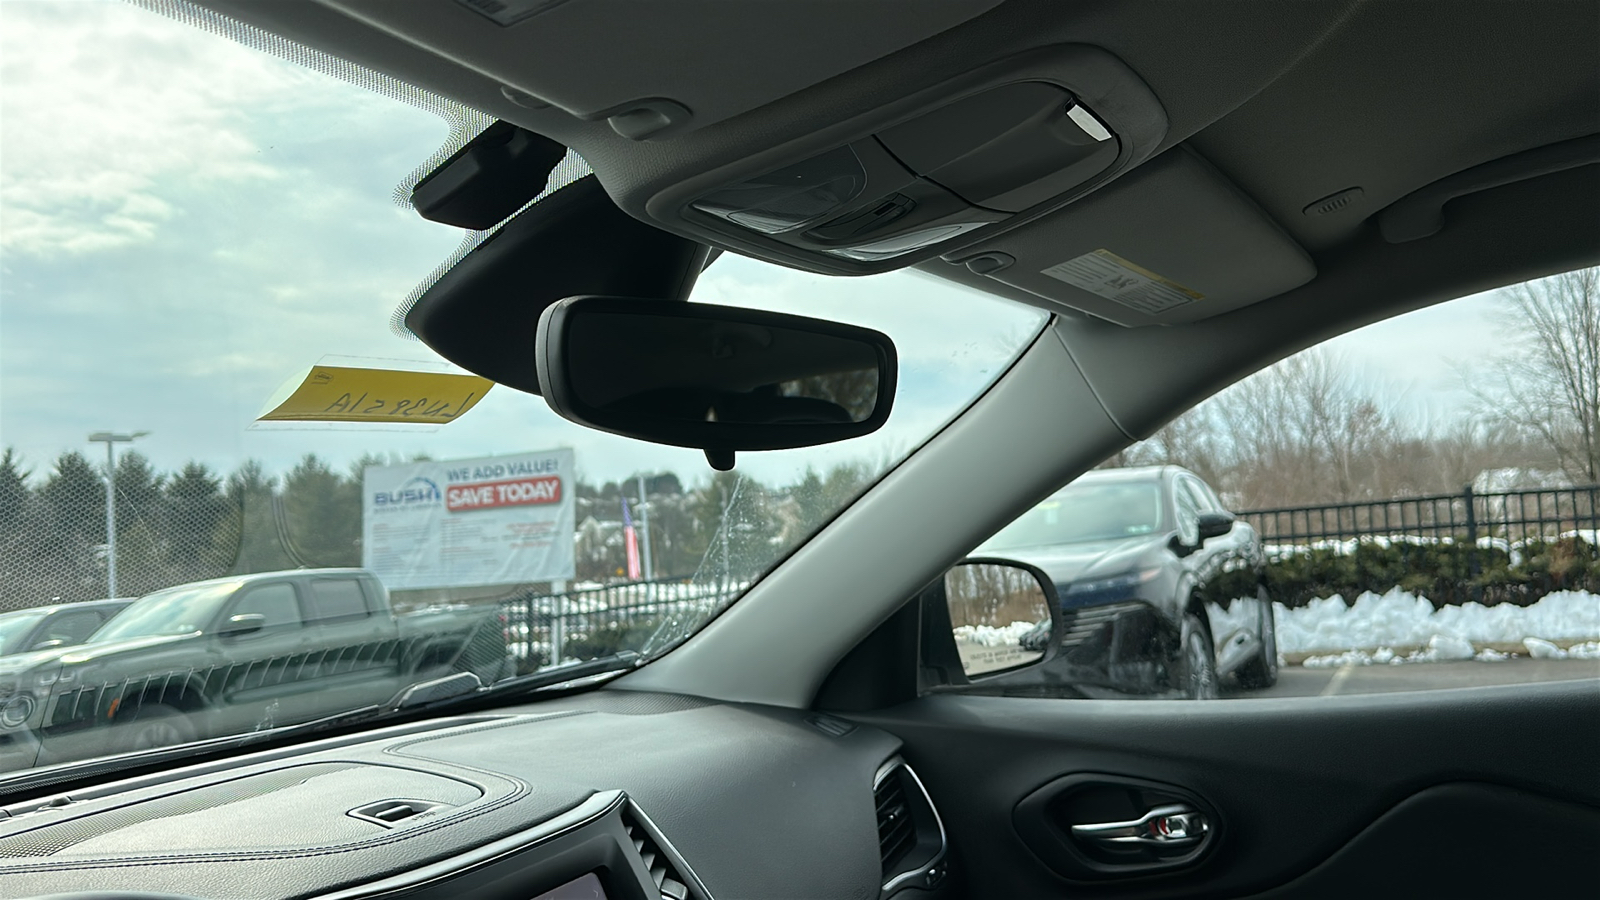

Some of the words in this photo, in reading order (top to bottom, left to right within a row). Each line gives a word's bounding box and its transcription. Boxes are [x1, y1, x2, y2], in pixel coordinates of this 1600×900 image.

[447, 468, 470, 481] WE
[472, 464, 505, 479] ADD
[507, 458, 559, 475] VALUE!
[374, 490, 433, 506] BUSH
[449, 486, 495, 507] SAVE
[496, 479, 559, 502] TODAY
